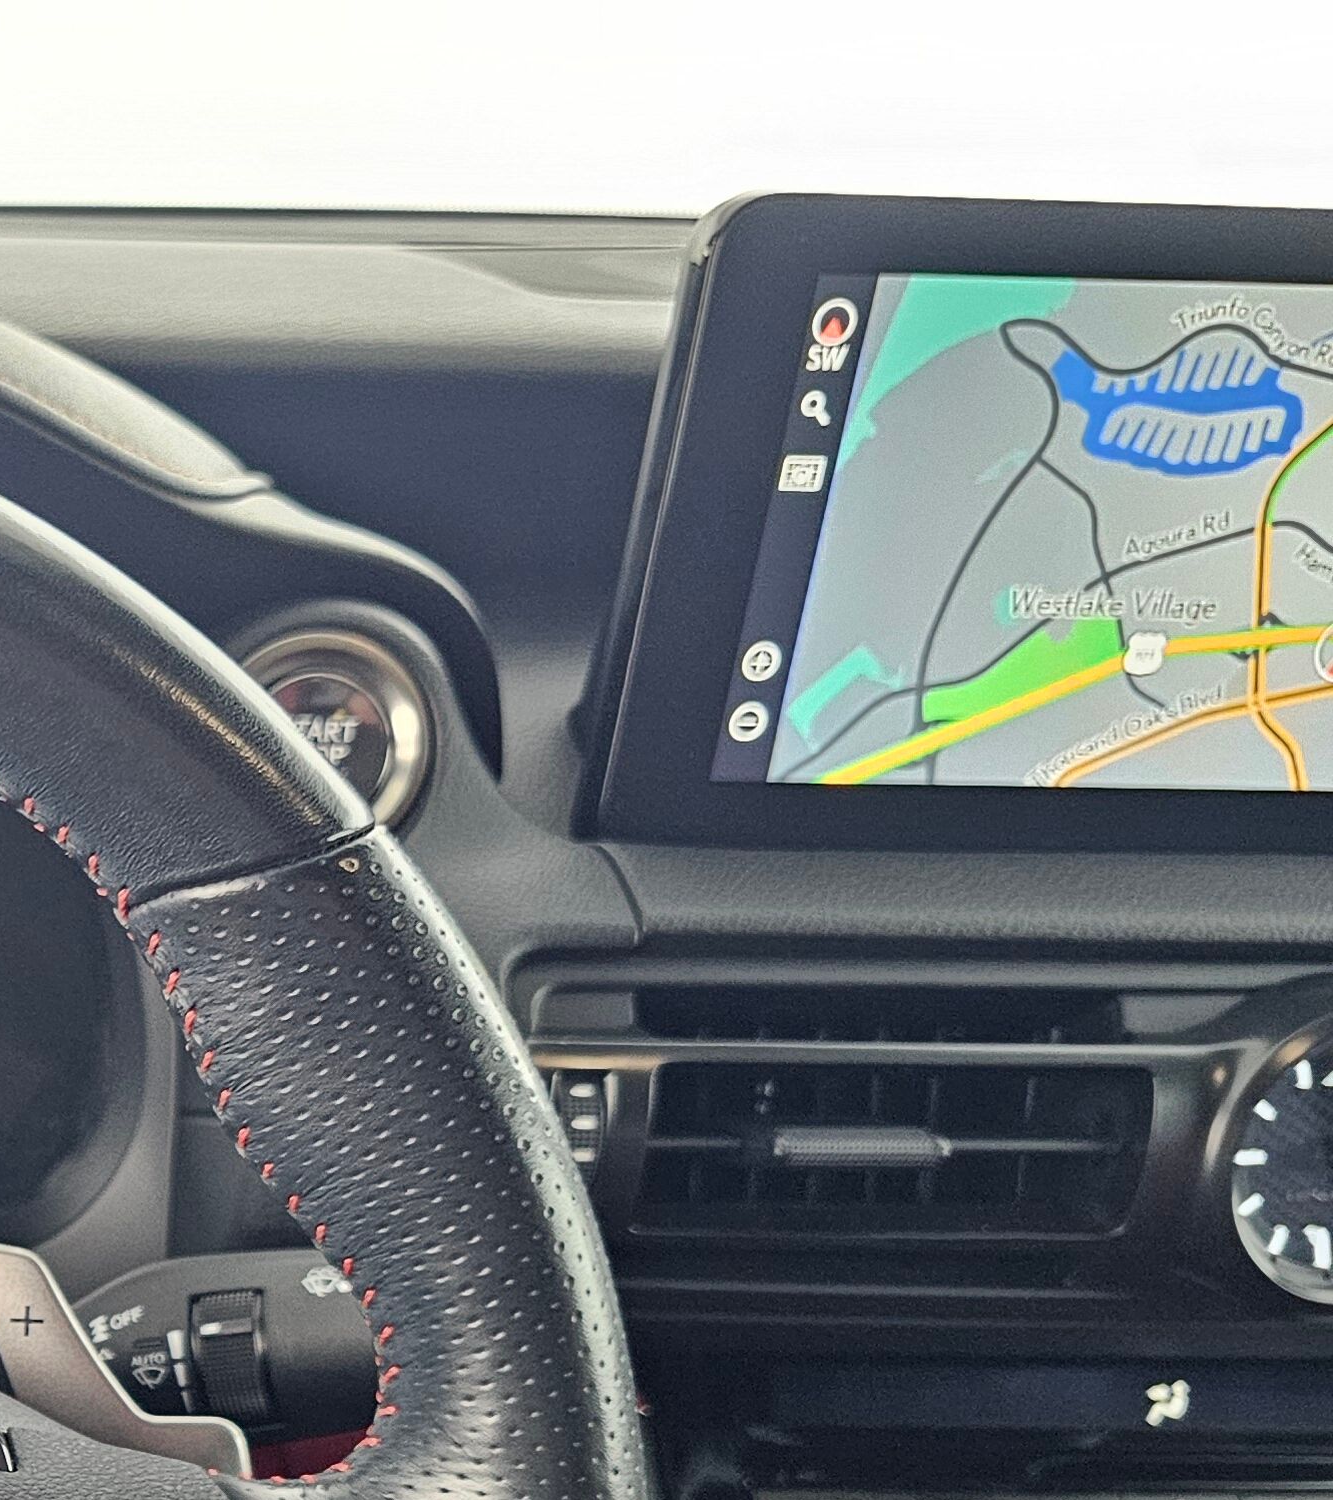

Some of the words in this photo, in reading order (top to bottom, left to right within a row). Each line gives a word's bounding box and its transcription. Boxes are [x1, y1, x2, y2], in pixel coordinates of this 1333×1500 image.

[806, 343, 850, 372] SW
[1125, 528, 1196, 555] Agoura
[1202, 511, 1230, 535] Rd
[1011, 587, 1124, 618] Westlake
[1134, 588, 1218, 626] Village
[291, 713, 363, 744] TART
[1124, 707, 1179, 737] Oaks
[132, 1351, 167, 1367] AUTO
